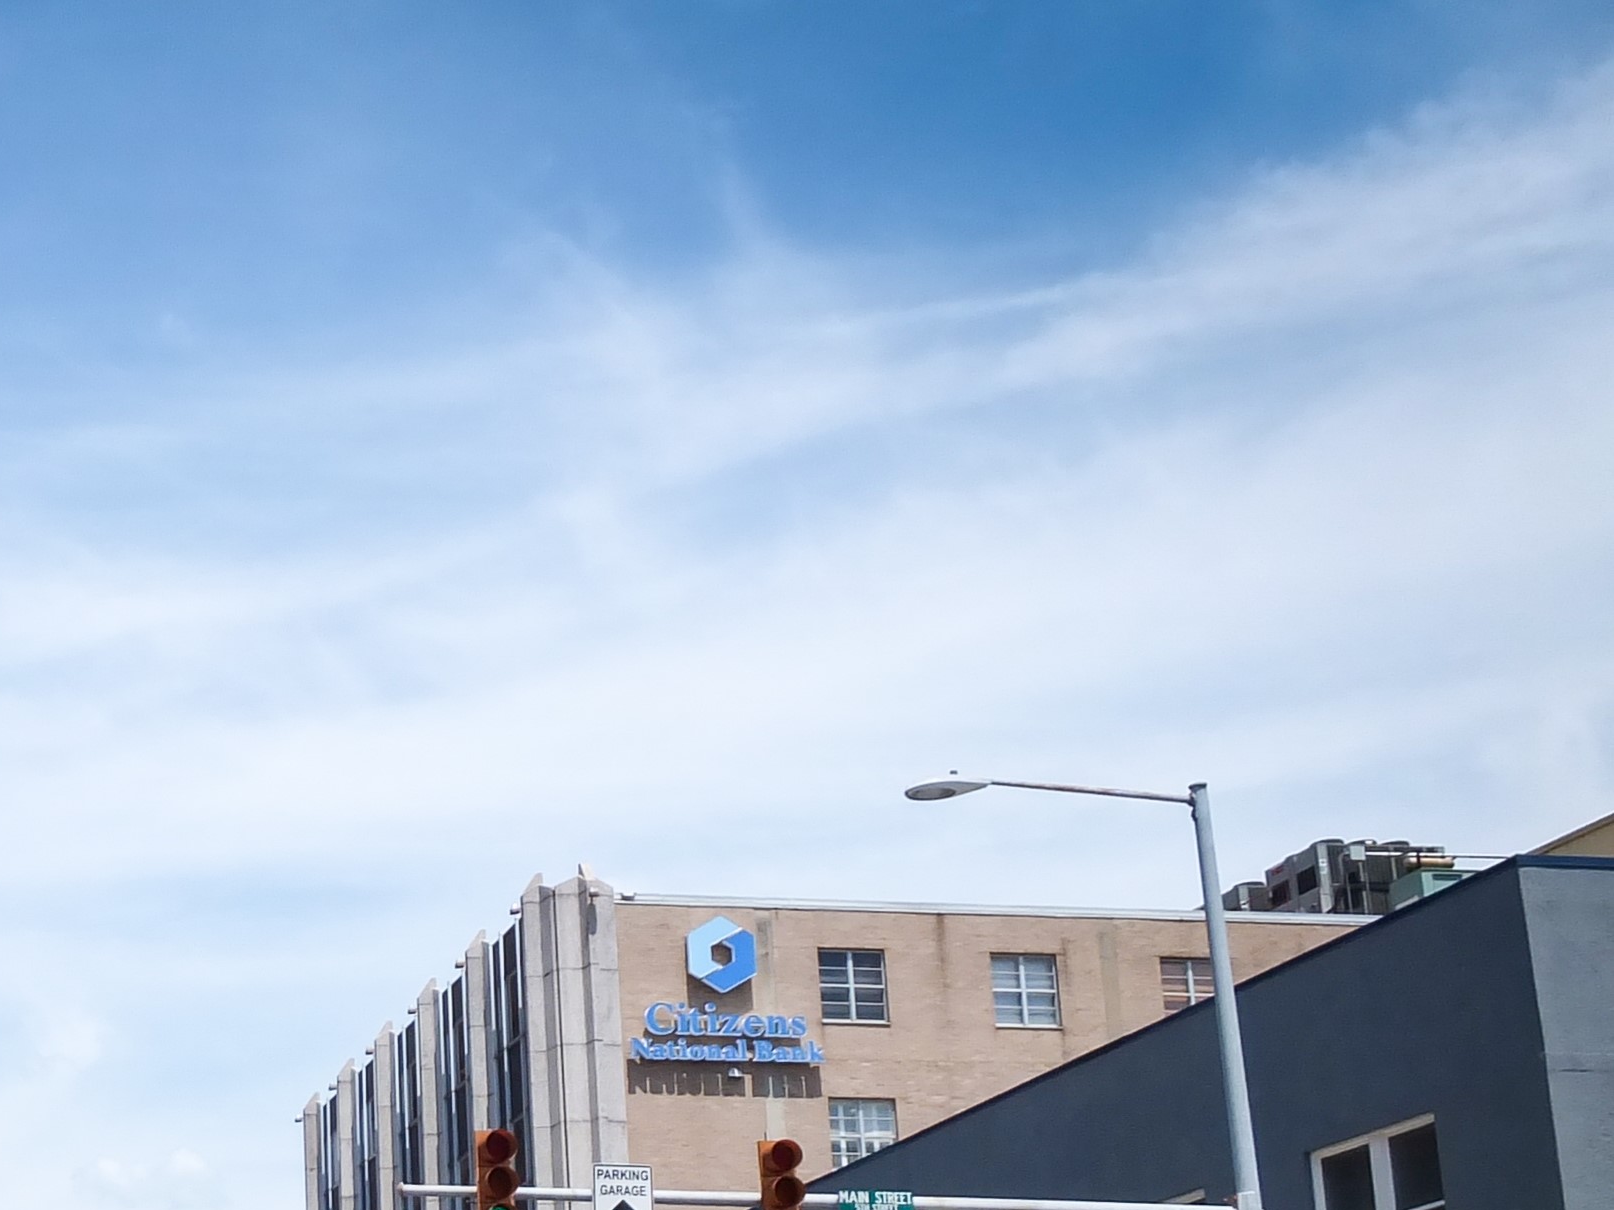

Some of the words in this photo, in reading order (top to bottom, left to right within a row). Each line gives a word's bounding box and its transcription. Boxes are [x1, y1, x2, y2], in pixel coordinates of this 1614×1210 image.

[644, 1001, 808, 1038] Citizens
[629, 1037, 749, 1061] National
[752, 1039, 826, 1064] Bank
[597, 1169, 649, 1181] PARKING
[600, 1184, 648, 1197] GARAGE
[838, 1190, 870, 1204] MAIN
[874, 1191, 912, 1205] STREET
